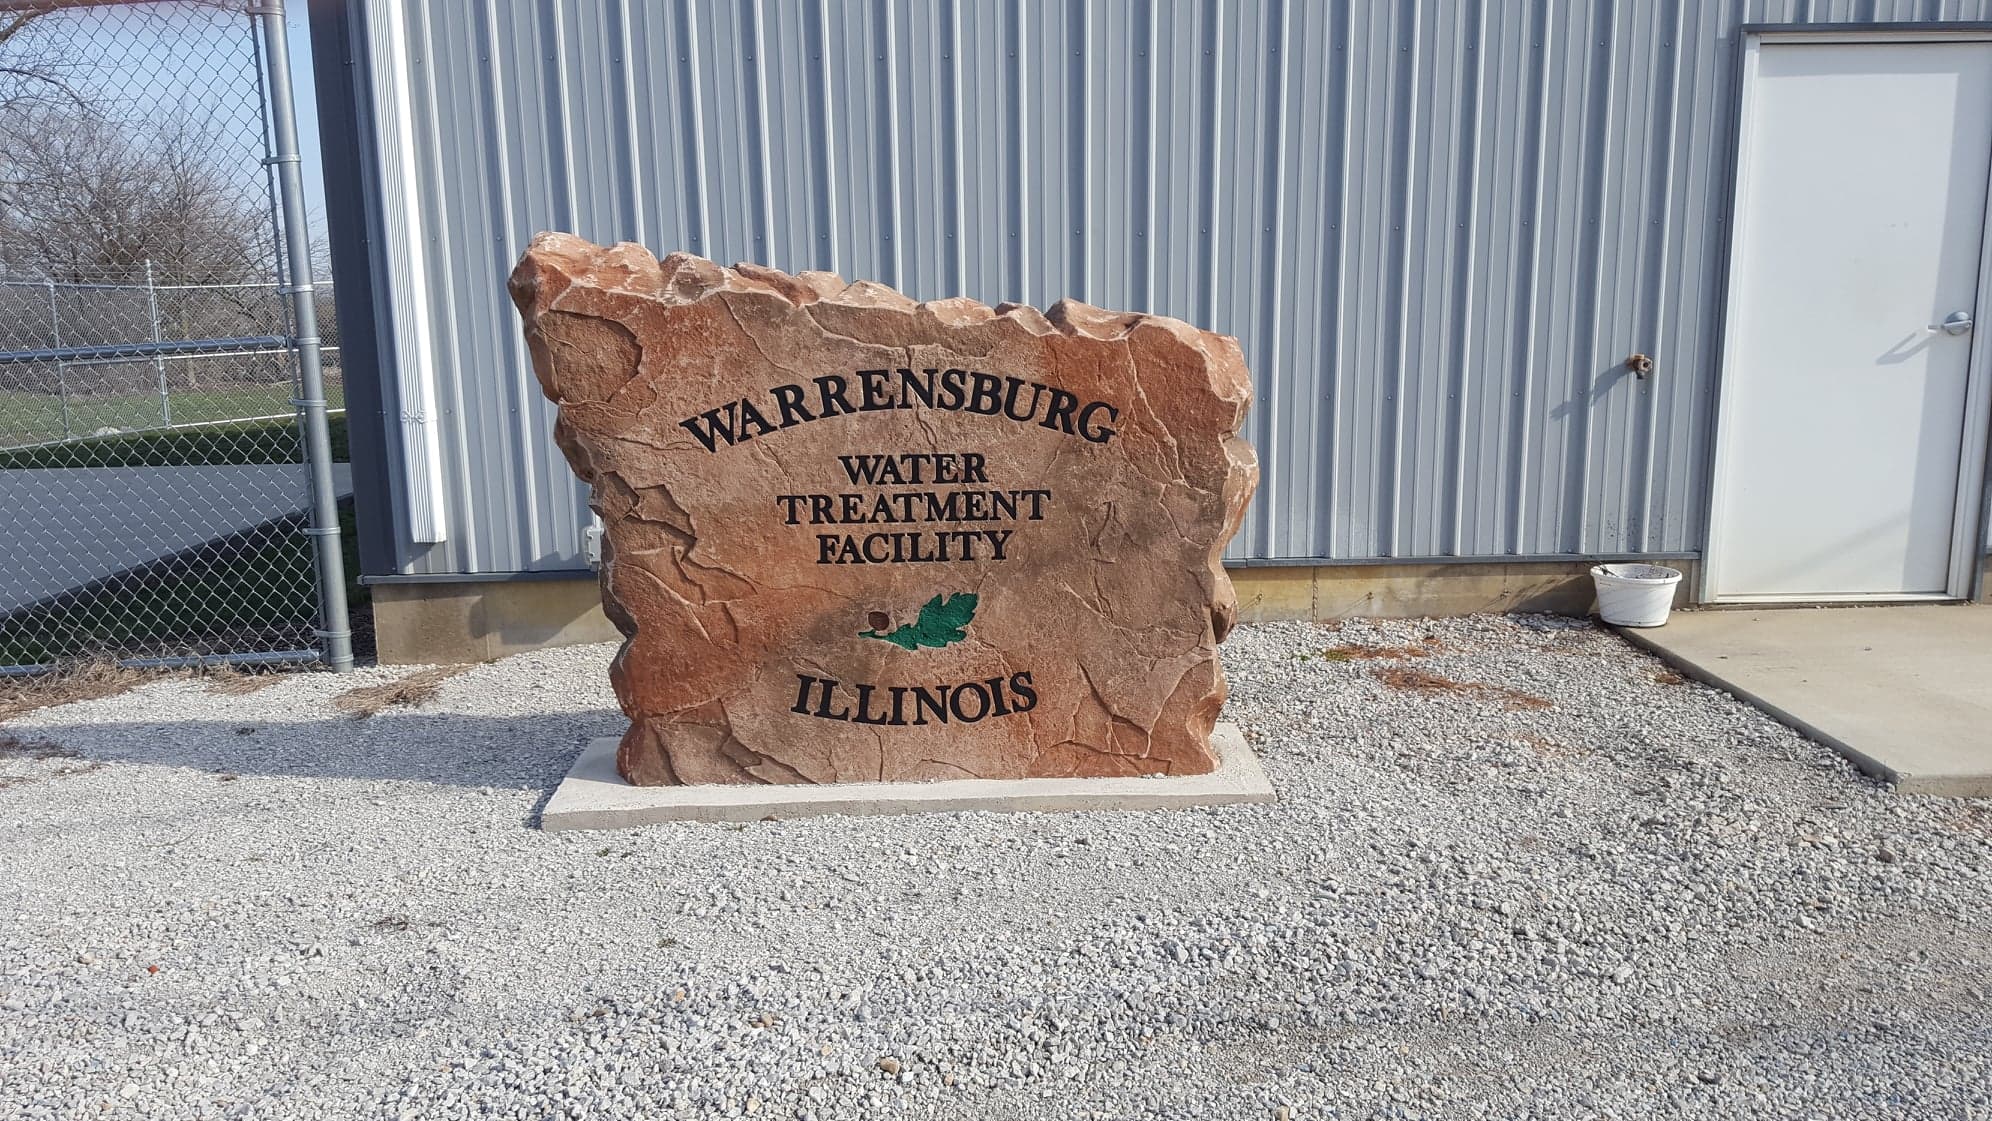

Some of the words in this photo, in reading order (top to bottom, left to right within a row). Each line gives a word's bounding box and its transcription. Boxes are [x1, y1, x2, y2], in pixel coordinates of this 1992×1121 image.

[679, 368, 1119, 454] WARRENSBURG
[838, 453, 989, 486] WATER
[776, 489, 1052, 526] TREATMENT
[815, 530, 1014, 565] FACILITY
[790, 670, 1039, 726] ILLINOIS
